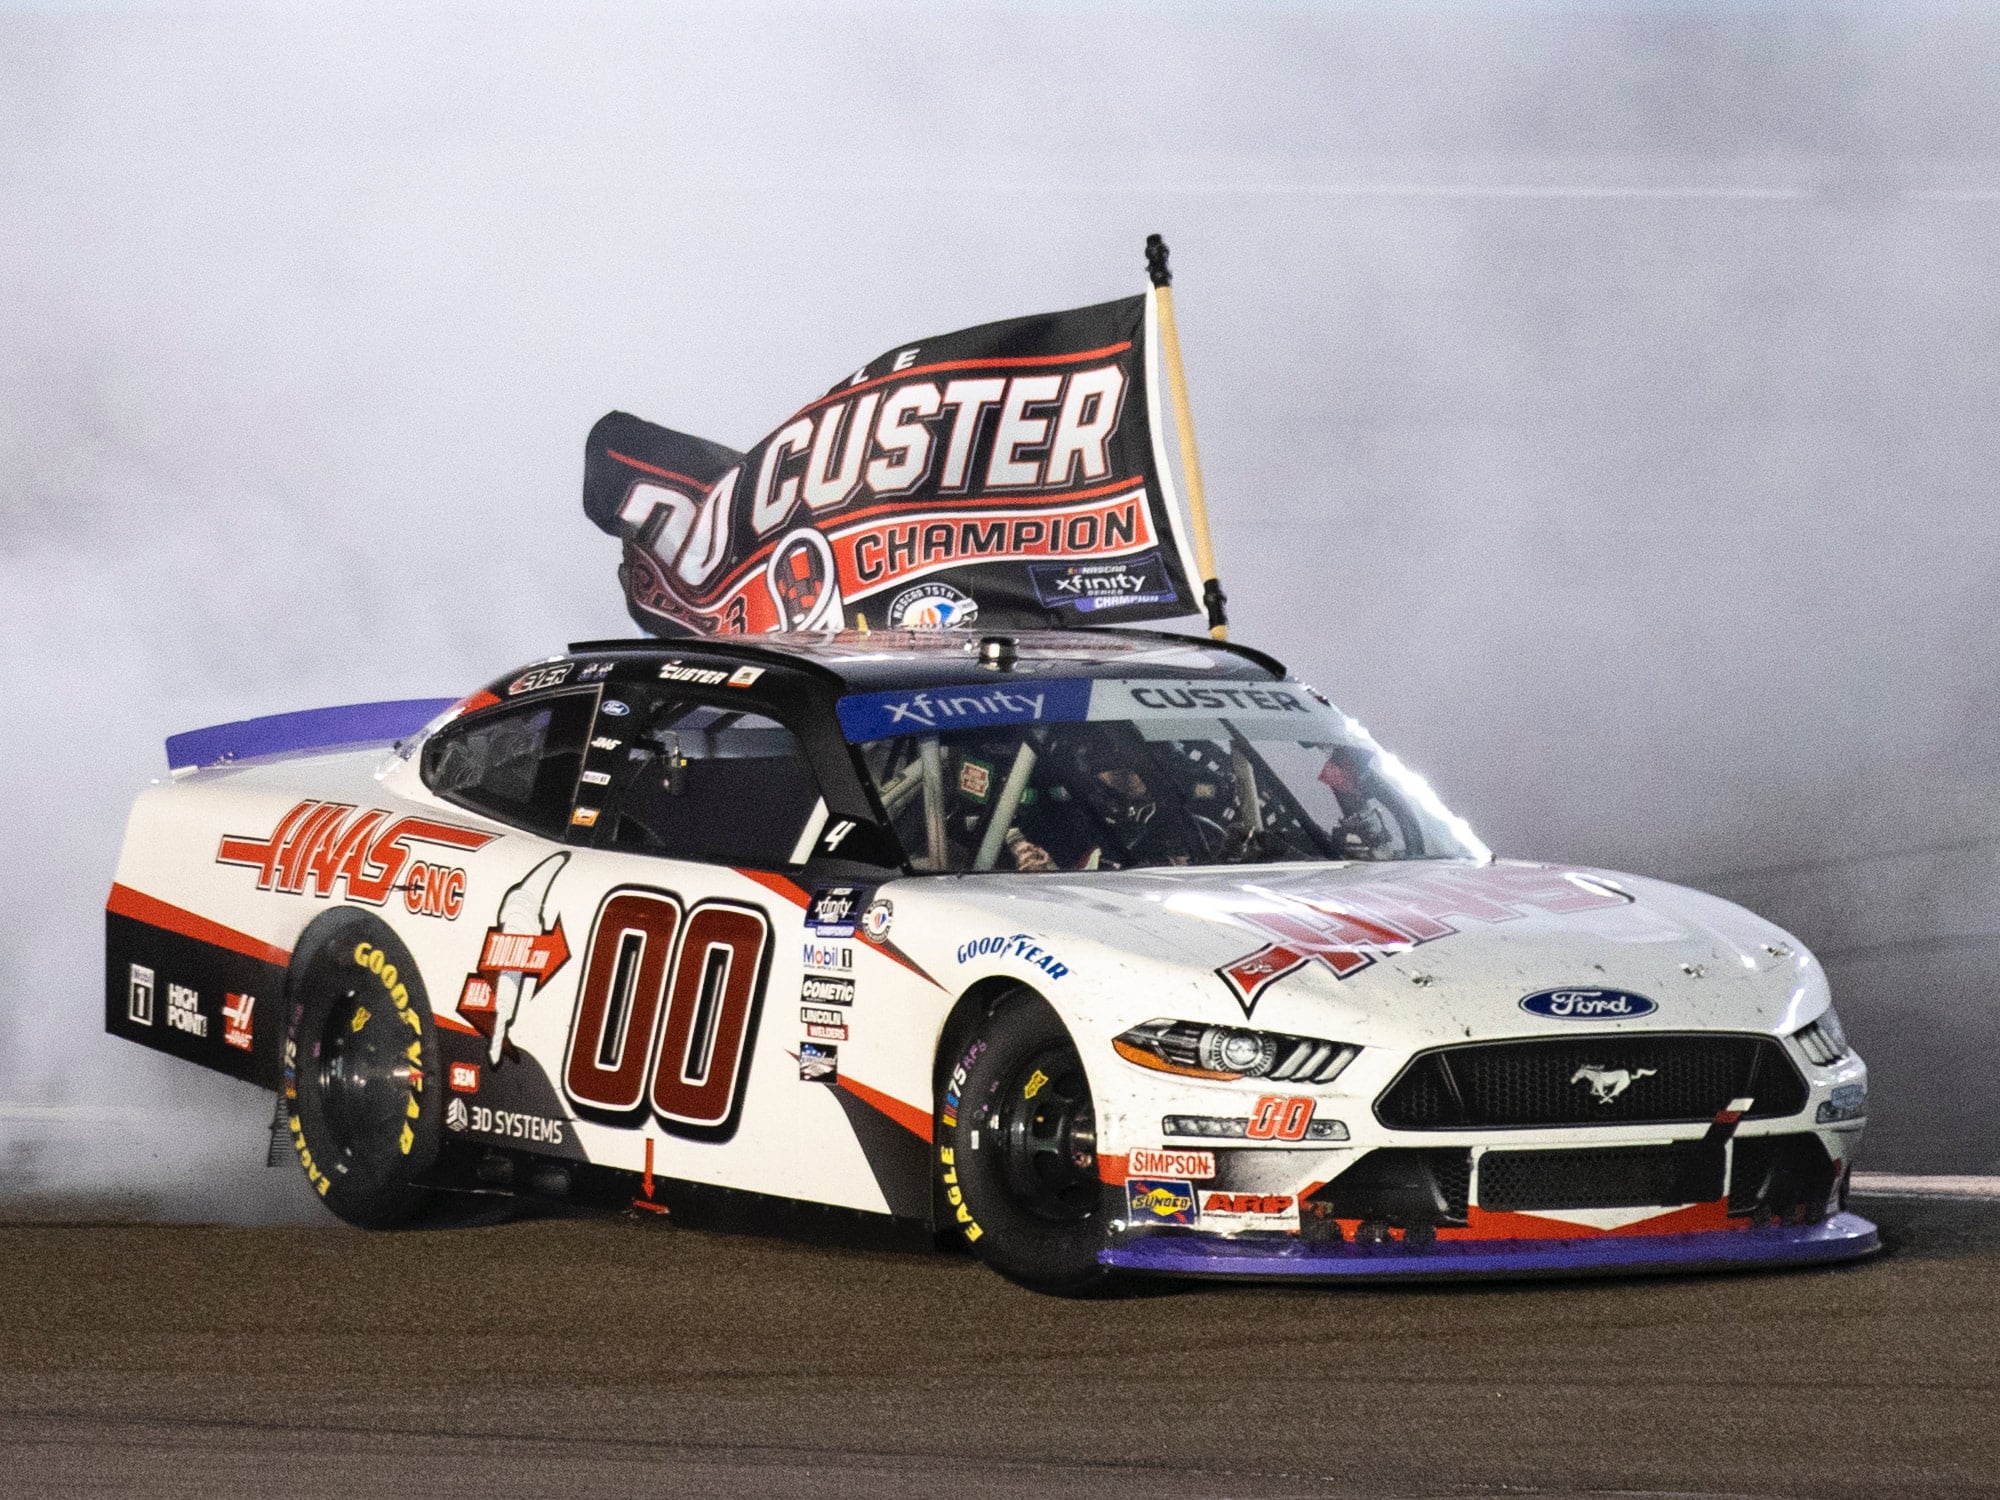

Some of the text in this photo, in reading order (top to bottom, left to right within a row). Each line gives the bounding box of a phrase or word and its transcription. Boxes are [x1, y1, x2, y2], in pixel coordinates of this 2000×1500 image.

[752, 363, 1123, 534] CUSTER
[856, 506, 1136, 582] CHAMPION
[1056, 574, 1146, 593] xfinity
[659, 661, 728, 685] CUSTER
[883, 691, 1044, 726] xfinity
[1131, 687, 1310, 713] CUSTER
[217, 800, 503, 920] HAAS CNC
[803, 944, 838, 966] Mobil
[803, 981, 854, 1002] COMETIC
[1551, 991, 1632, 1016] Ford
[564, 887, 769, 1134] 00
[471, 1106, 562, 1144] 3D SYSTEMS
[1247, 1095, 1316, 1140] 00
[1134, 1152, 1208, 1175] SIMPSON
[941, 1145, 984, 1242] EAGLE
[1133, 1195, 1191, 1209] SUNOCO
[1203, 1193, 1294, 1214] ARP
